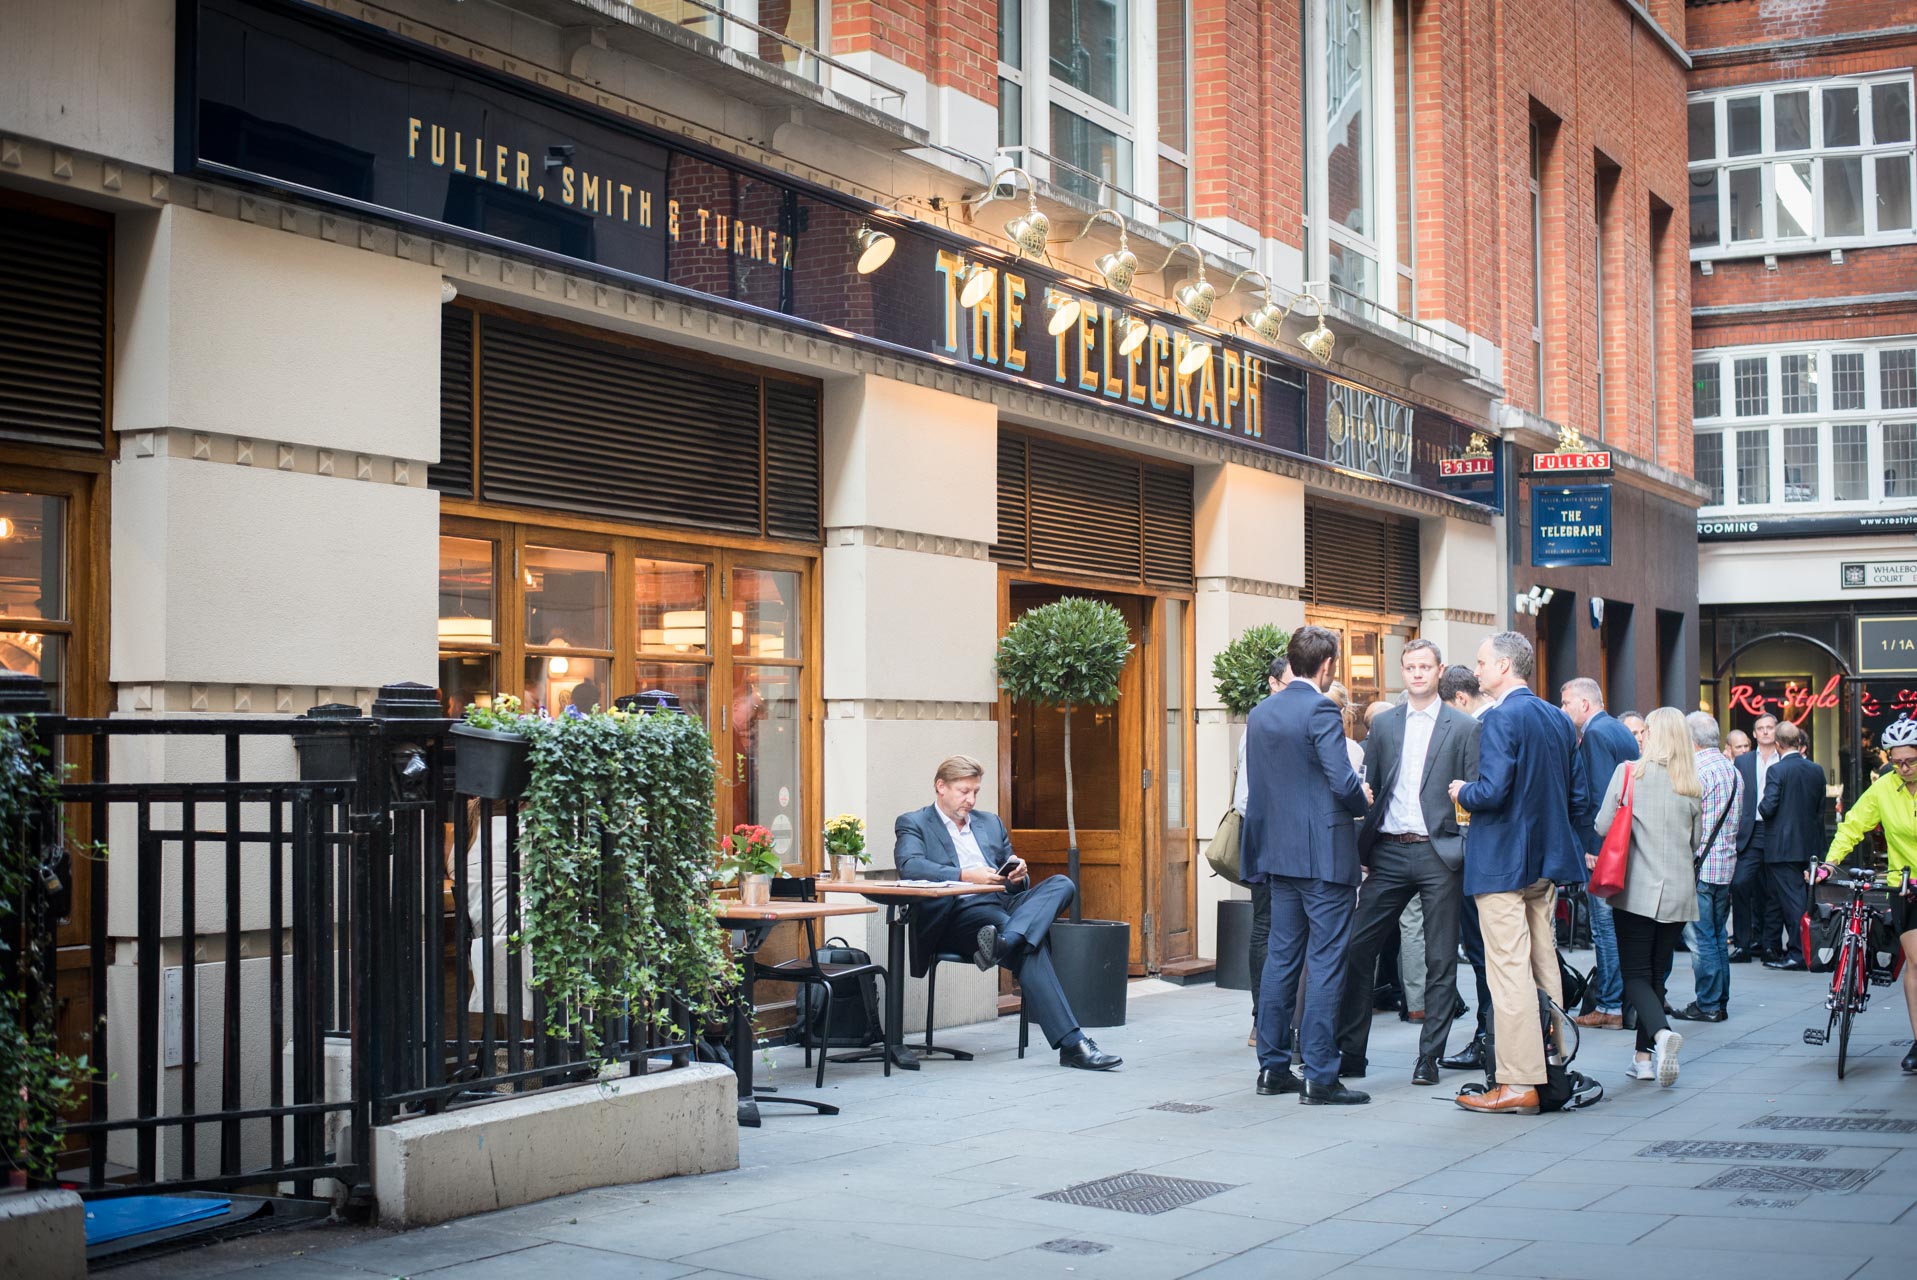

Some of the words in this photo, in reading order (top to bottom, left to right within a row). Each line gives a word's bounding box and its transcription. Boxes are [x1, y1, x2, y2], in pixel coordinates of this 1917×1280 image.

[408, 117, 544, 201] FULLER,
[562, 166, 652, 229] SMITH
[668, 200, 680, 243] &
[697, 208, 792, 271] TURNER
[935, 249, 1027, 371] THE
[1044, 286, 1263, 438] TELEGRAPH
[1537, 454, 1605, 469] FULLER'S
[1561, 510, 1582, 522] THE
[1540, 525, 1602, 538] TELEGRAPH
[1873, 575, 1903, 583] COURT
[1899, 640, 1915, 650] 1A
[1728, 674, 1841, 726] Re-Style
